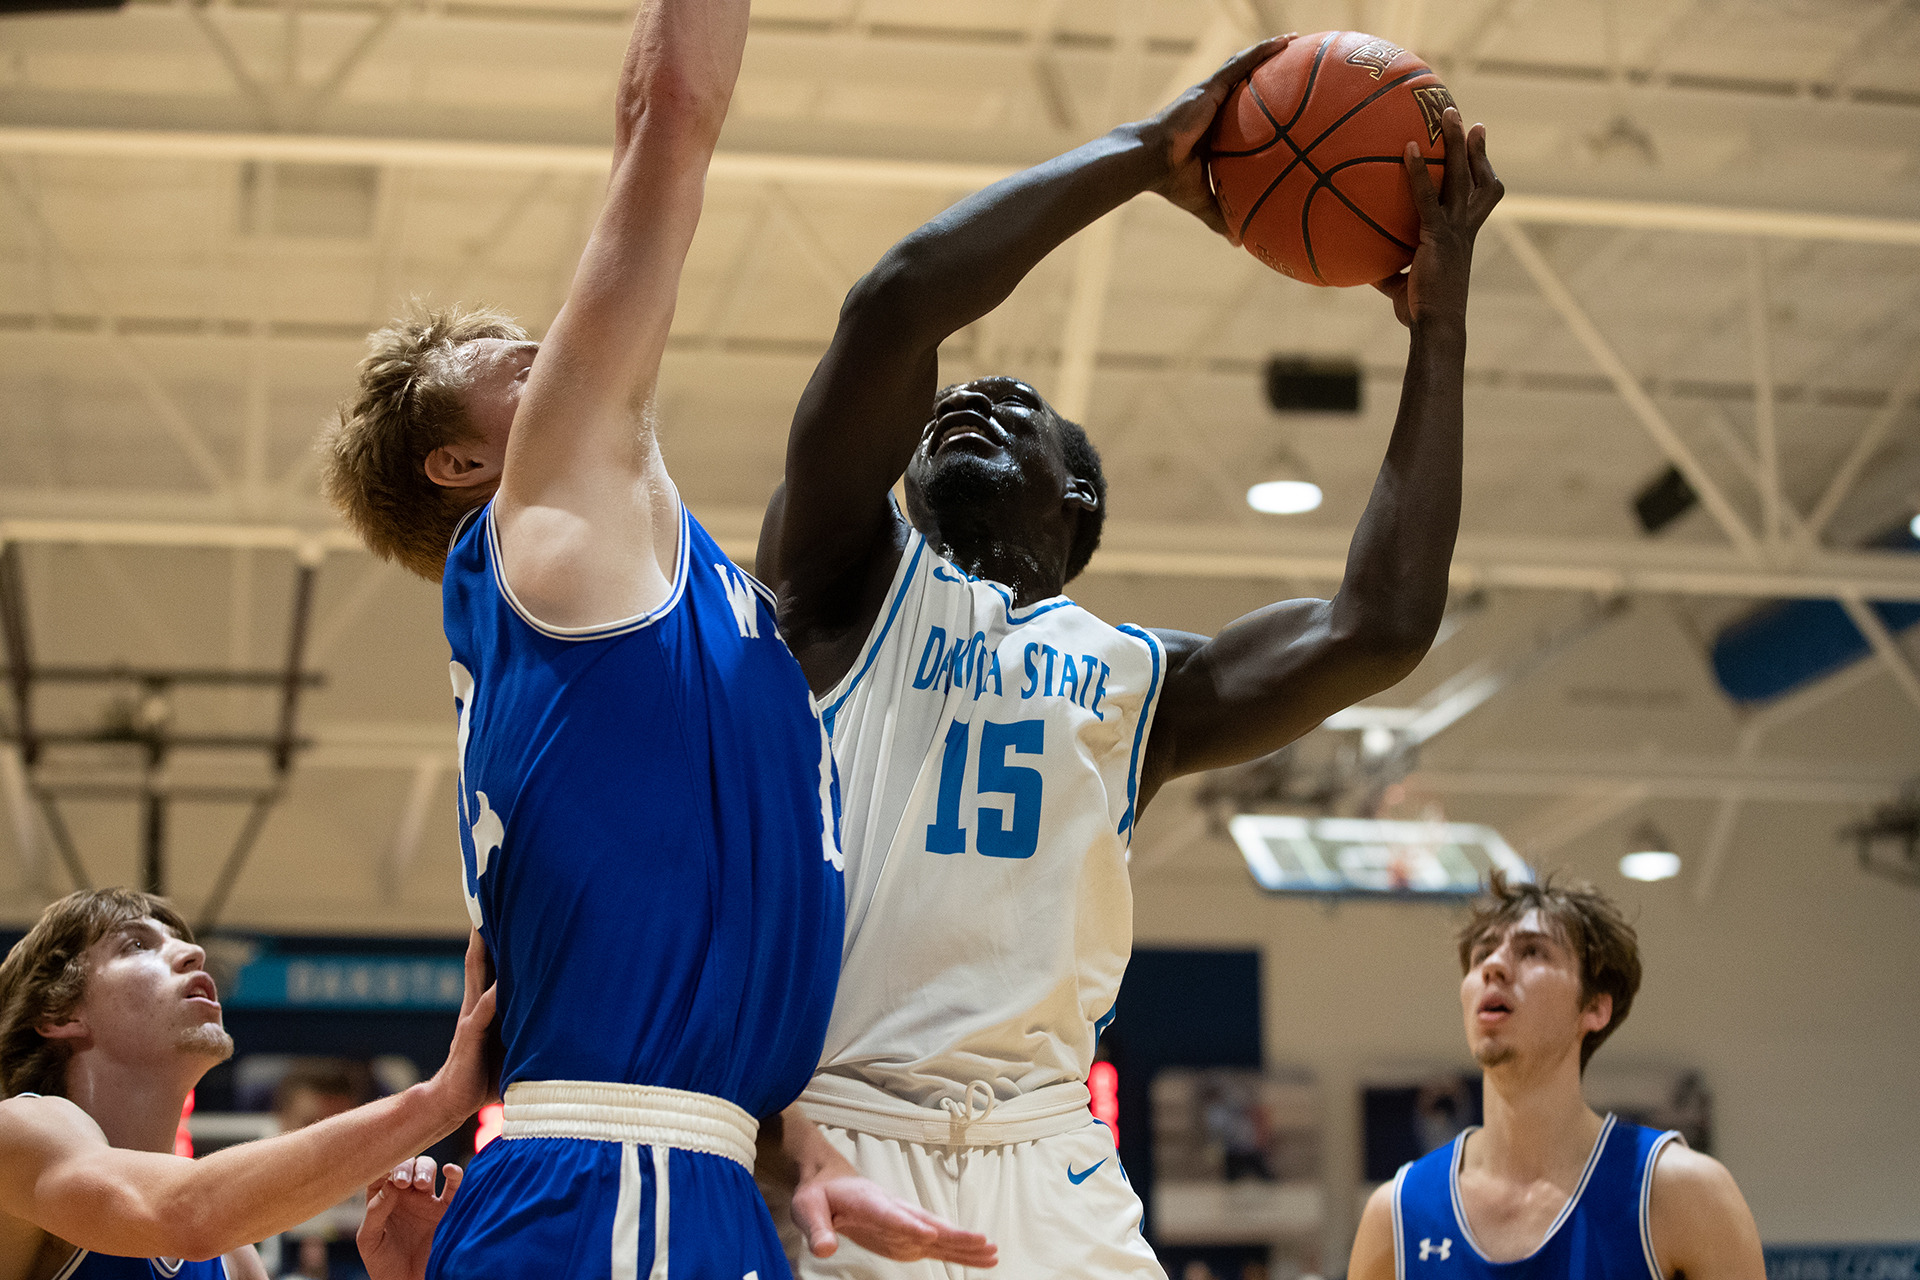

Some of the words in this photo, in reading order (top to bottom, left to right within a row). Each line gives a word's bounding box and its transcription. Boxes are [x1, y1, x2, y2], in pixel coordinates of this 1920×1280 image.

[912, 625, 1003, 701] DAKOTA
[1021, 642, 1111, 722] STATE
[925, 716, 1045, 860] 15
